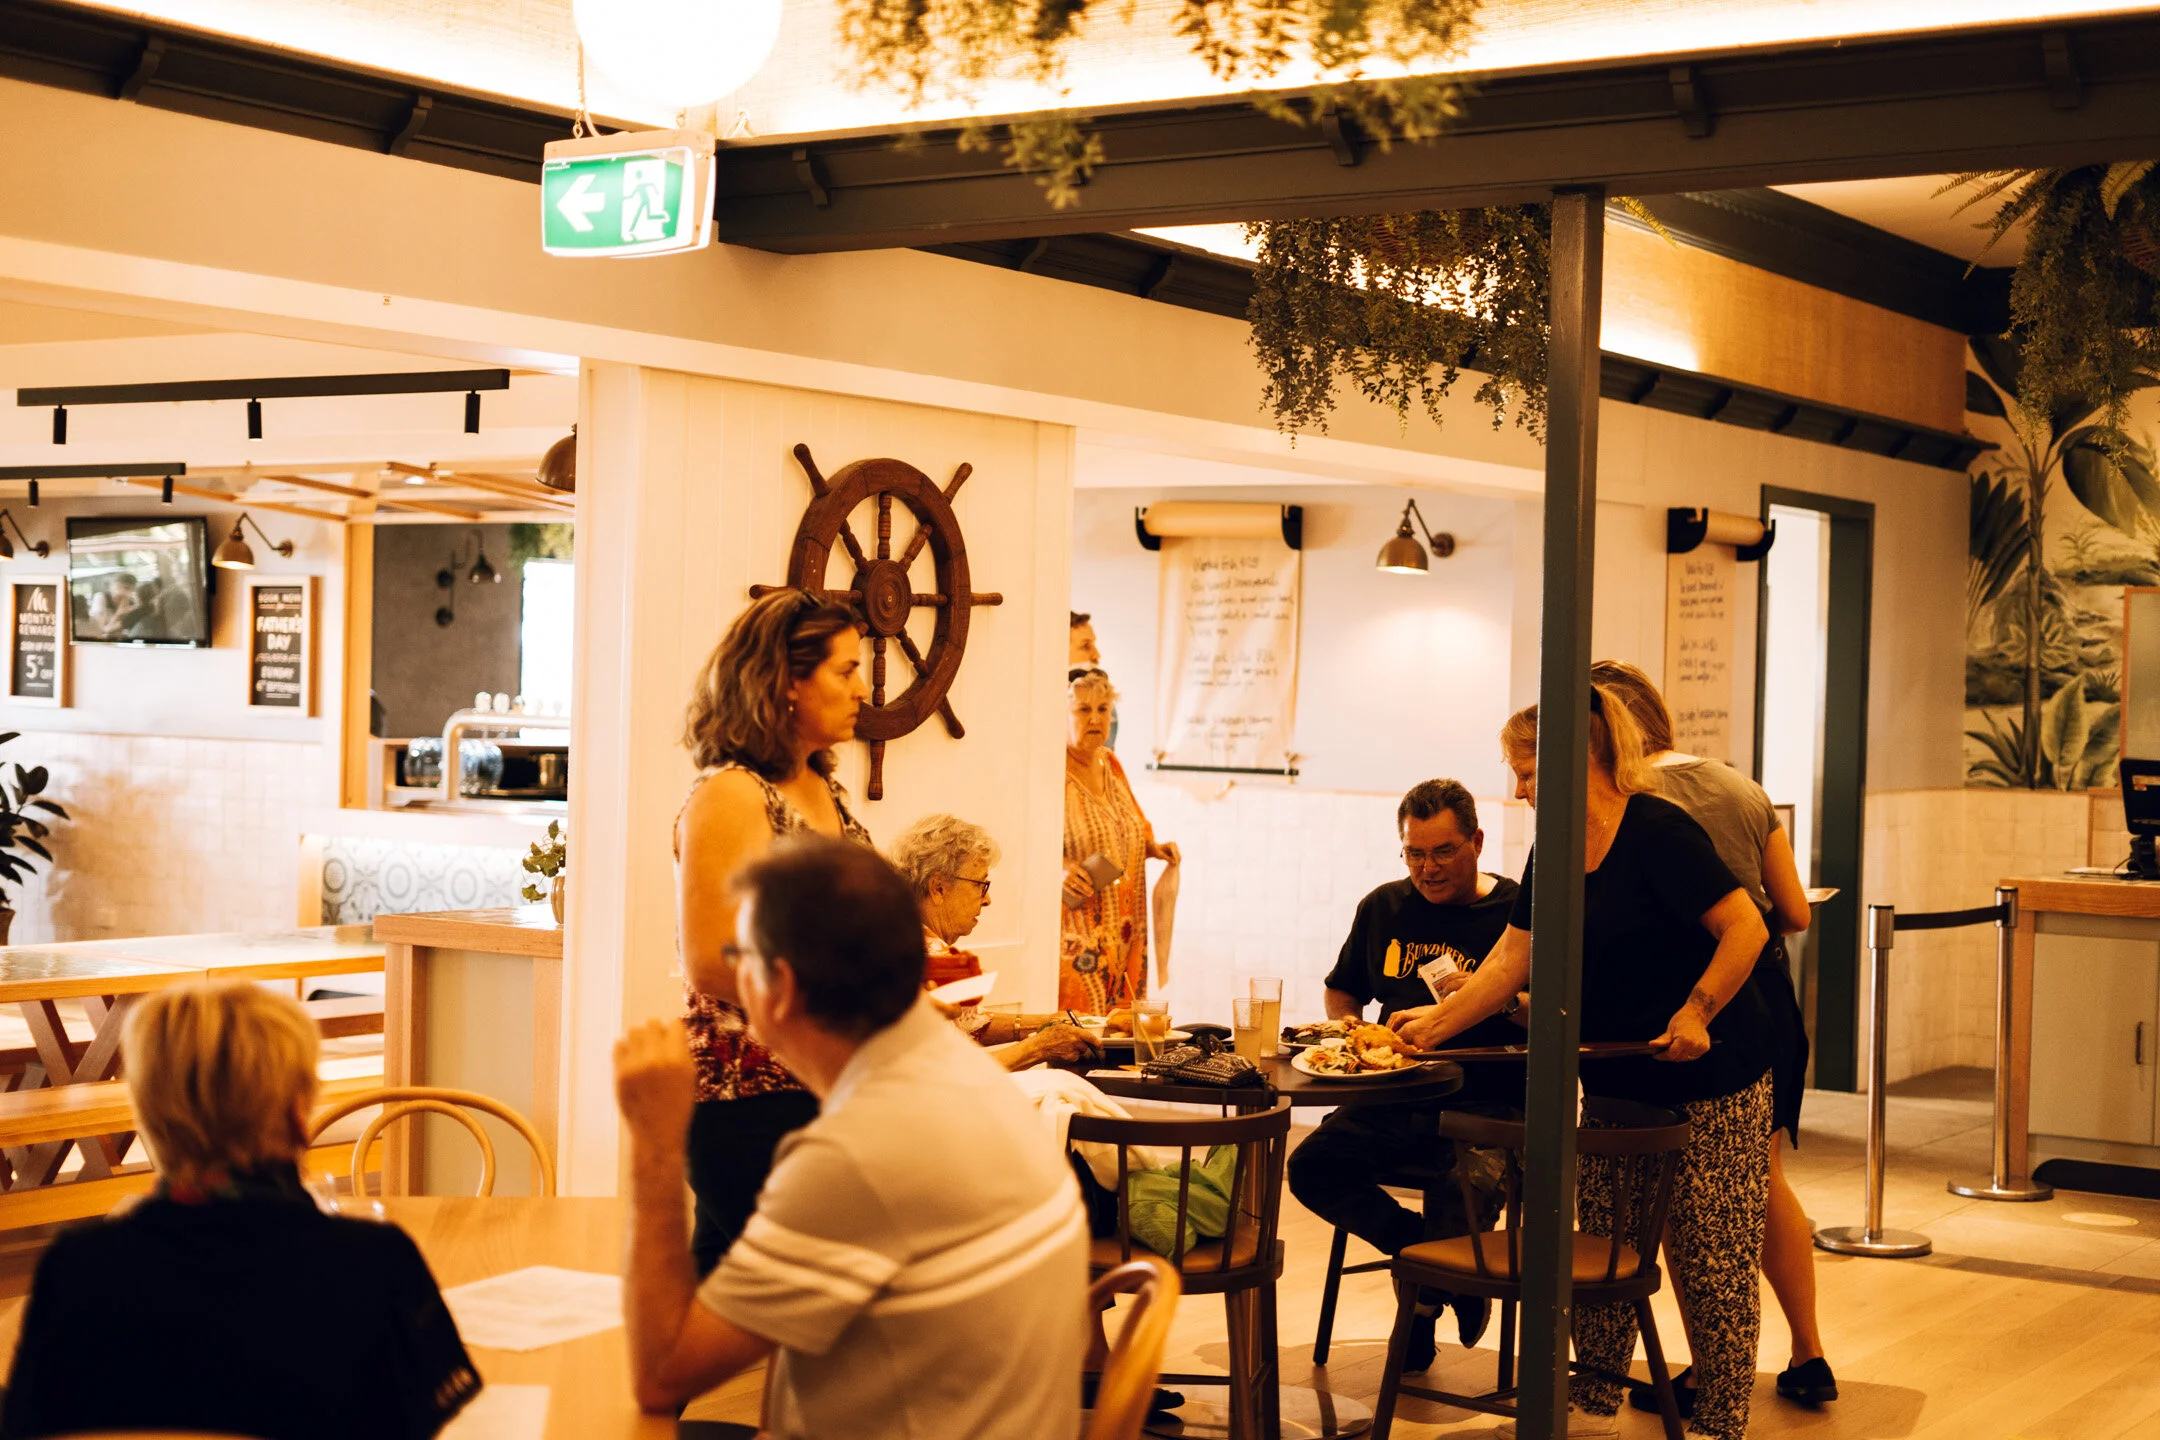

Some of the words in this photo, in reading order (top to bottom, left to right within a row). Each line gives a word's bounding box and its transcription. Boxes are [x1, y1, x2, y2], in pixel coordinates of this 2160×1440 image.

[256, 613, 303, 633] FATHER'S
[267, 633, 292, 651] DAY
[1399, 941, 1477, 979] BUNDABERG
